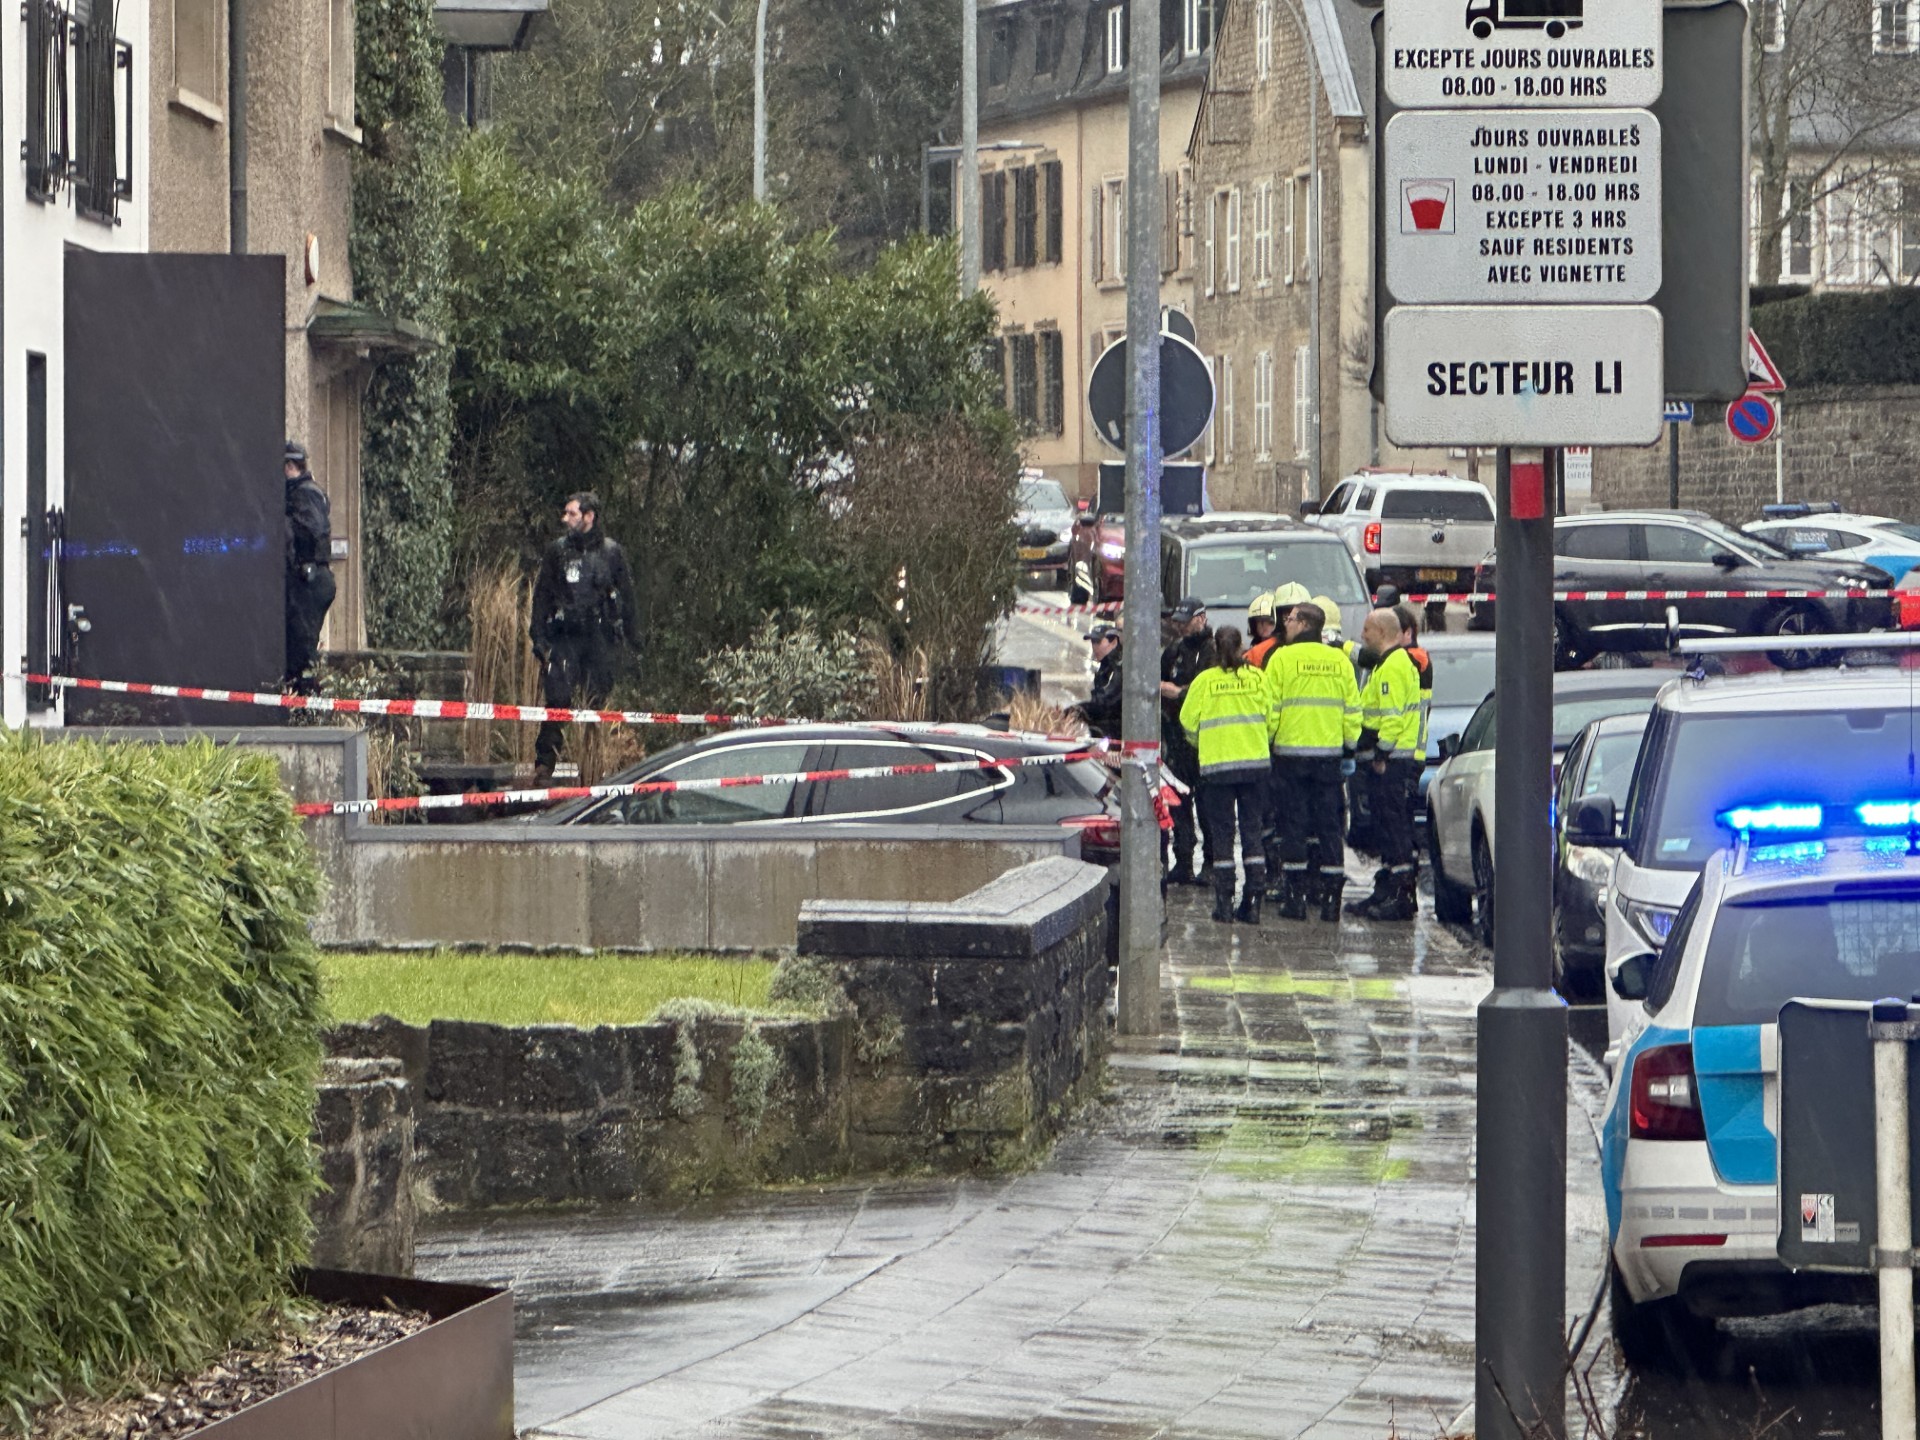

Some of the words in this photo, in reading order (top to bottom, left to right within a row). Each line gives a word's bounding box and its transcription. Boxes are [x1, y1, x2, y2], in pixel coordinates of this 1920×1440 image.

[1394, 48, 1475, 69] EXCEPTE
[1480, 48, 1542, 69] JOURS
[1547, 48, 1654, 69] OUVRABLES
[1442, 76, 1496, 97] 08.00
[1514, 76, 1565, 97] 18.00
[1570, 76, 1607, 97] HRS
[1470, 128, 1529, 148] JOURS
[1537, 127, 1641, 148] OUVRABLES
[1474, 156, 1528, 175] LUNDI
[1548, 155, 1638, 174] VENDREDI
[1471, 183, 1524, 203] 08.00
[1547, 182, 1597, 202] 18.00
[1604, 182, 1640, 202] HRS
[1486, 210, 1564, 229] EXCEPTE
[1572, 209, 1583, 229] 3
[1591, 209, 1627, 229] HRS
[1479, 238, 1525, 257] SAUF
[1533, 237, 1634, 256] RESIDENTS
[1487, 264, 1531, 284] AVEC
[1539, 264, 1626, 283] VIGNETTE
[1427, 361, 1574, 397] SECTEUR
[1595, 360, 1622, 395] LI
